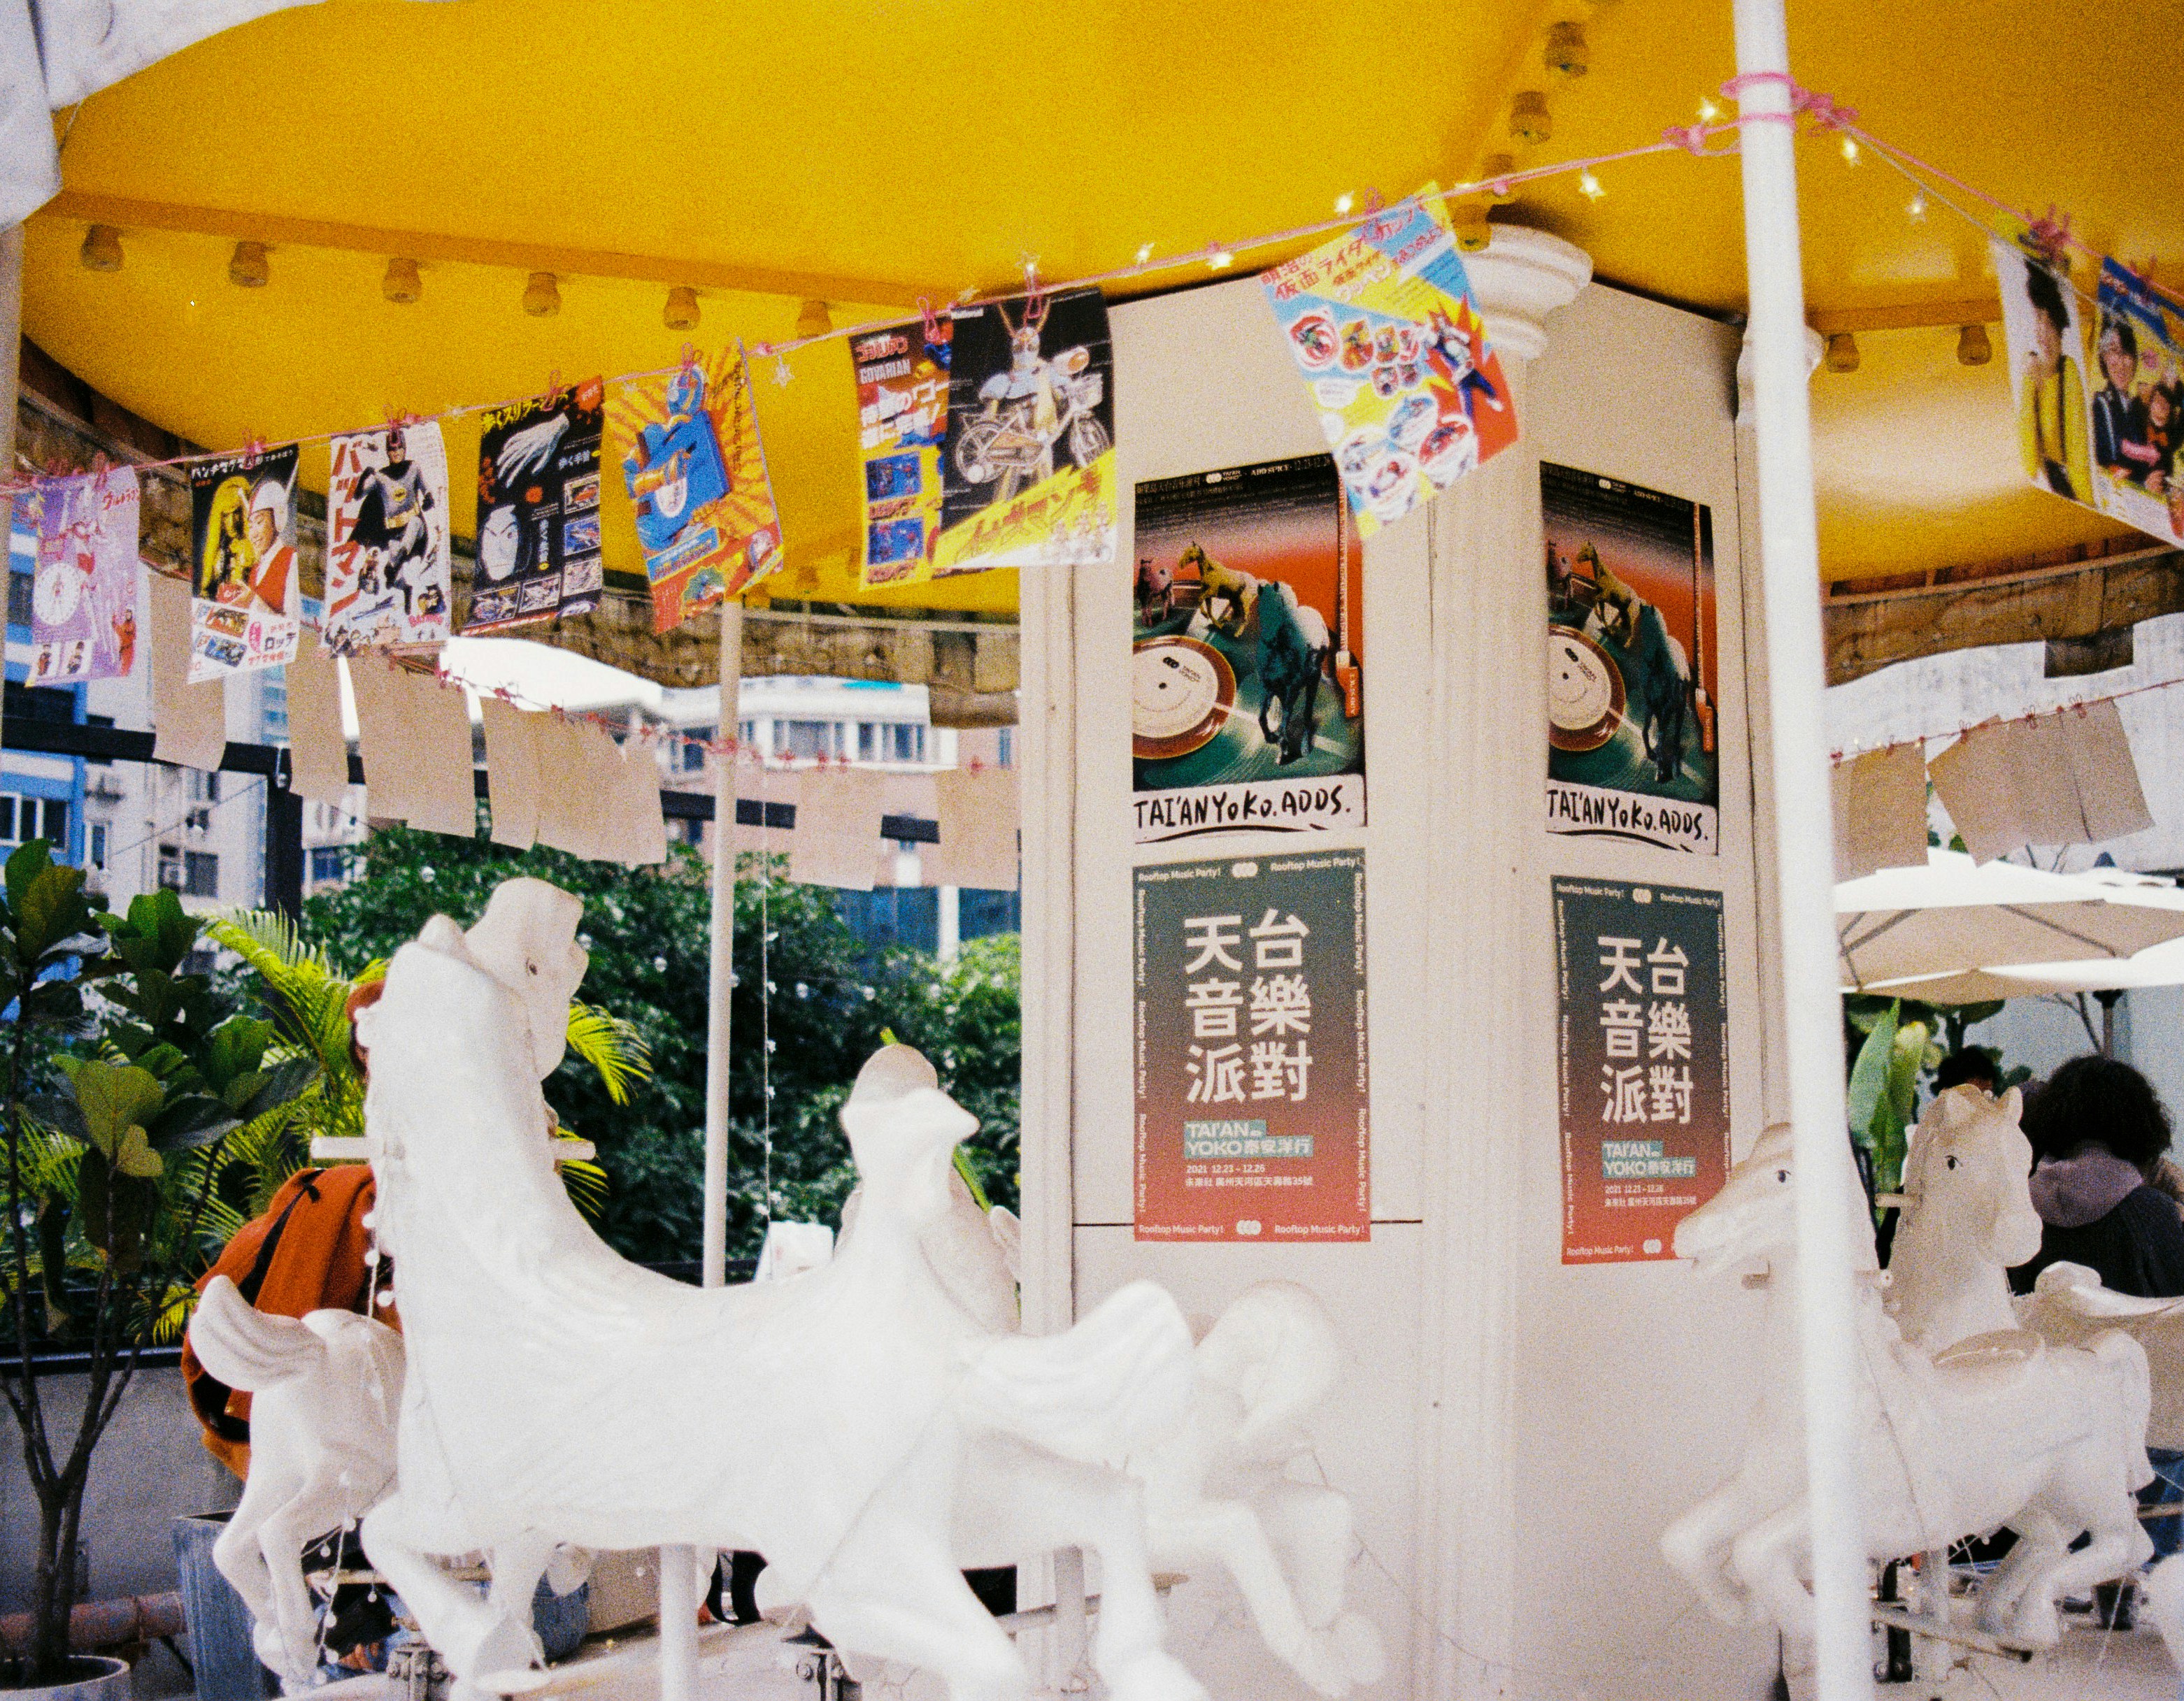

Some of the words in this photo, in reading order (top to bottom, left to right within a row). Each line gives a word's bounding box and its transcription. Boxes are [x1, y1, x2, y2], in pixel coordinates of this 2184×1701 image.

[859, 358, 912, 385] GOVARIAN
[329, 441, 363, 618] バットマン
[1185, 909, 1311, 975] 天台
[1597, 936, 1690, 995] 天台
[1185, 974, 1311, 1038] 音樂
[1599, 998, 1692, 1061] 音樂
[1185, 1040, 1313, 1103] 派對
[1599, 1063, 1694, 1124] 派對
[1186, 1140, 1243, 1156] YOKO
[1187, 1164, 1208, 1174] 2021
[1212, 1163, 1234, 1174] 12.23
[1243, 1163, 1266, 1173] 12.26
[1604, 1160, 1646, 1176] YOKO
